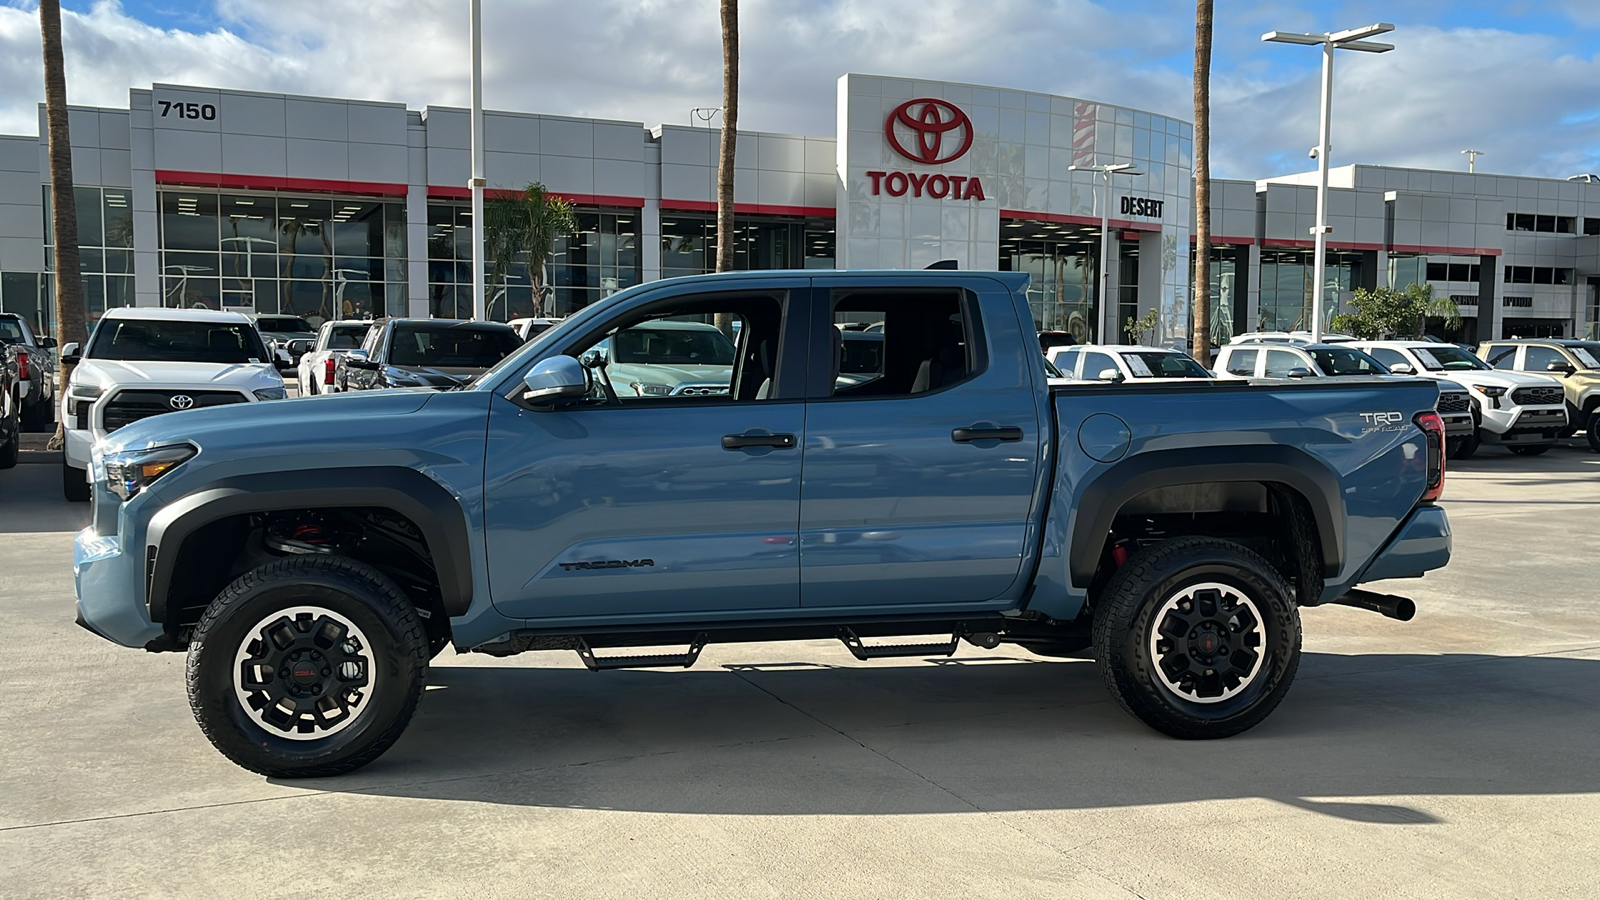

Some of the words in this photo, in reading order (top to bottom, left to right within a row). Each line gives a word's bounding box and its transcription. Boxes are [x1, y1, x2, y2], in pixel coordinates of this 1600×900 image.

[158, 100, 216, 121] 7150
[866, 171, 985, 201] TOYOTA
[1121, 196, 1164, 218] DESERT
[1359, 411, 1403, 425] TRD
[559, 558, 654, 571] TACOMA
